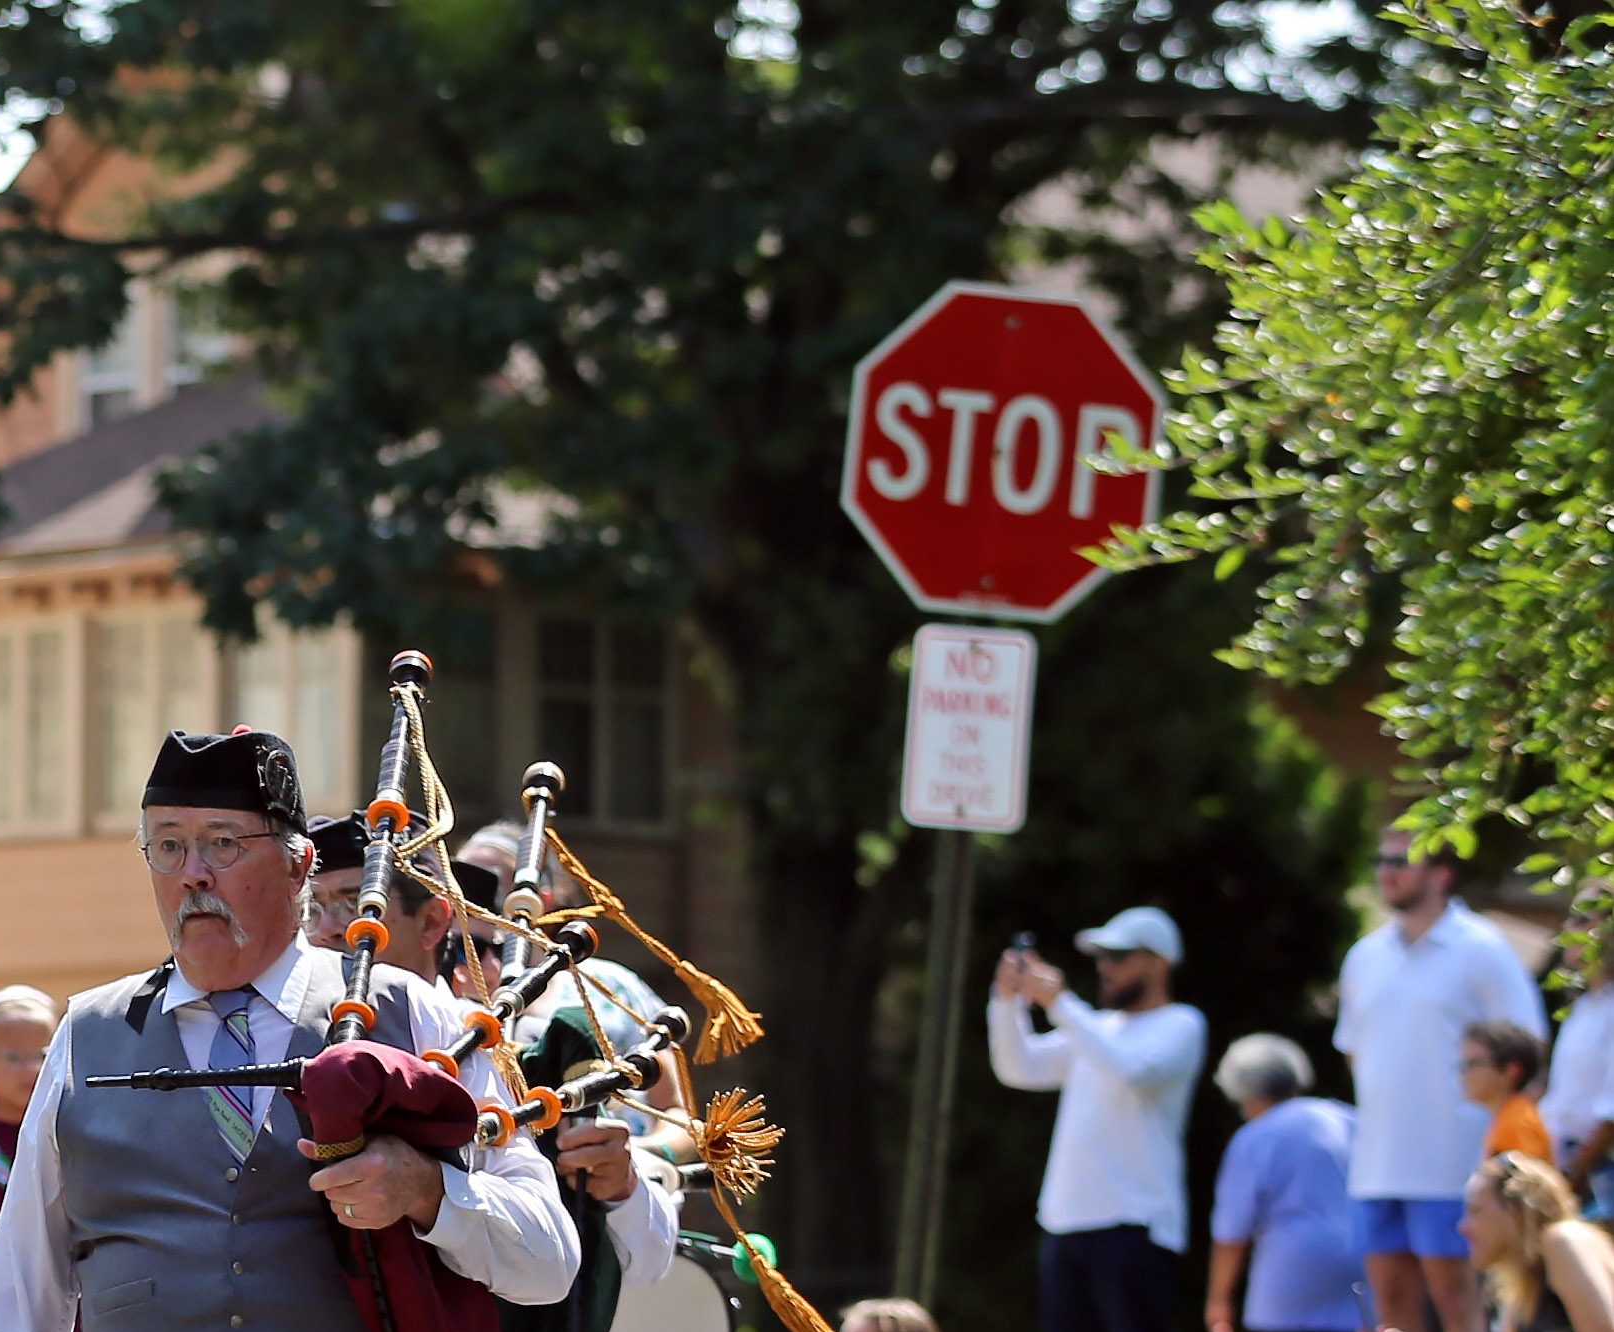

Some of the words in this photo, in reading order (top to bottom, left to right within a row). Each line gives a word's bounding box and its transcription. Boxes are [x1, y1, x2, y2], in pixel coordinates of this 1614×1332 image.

[867, 381, 1140, 520] STOP
[945, 648, 1000, 684] NO
[923, 687, 1011, 720] PARKING
